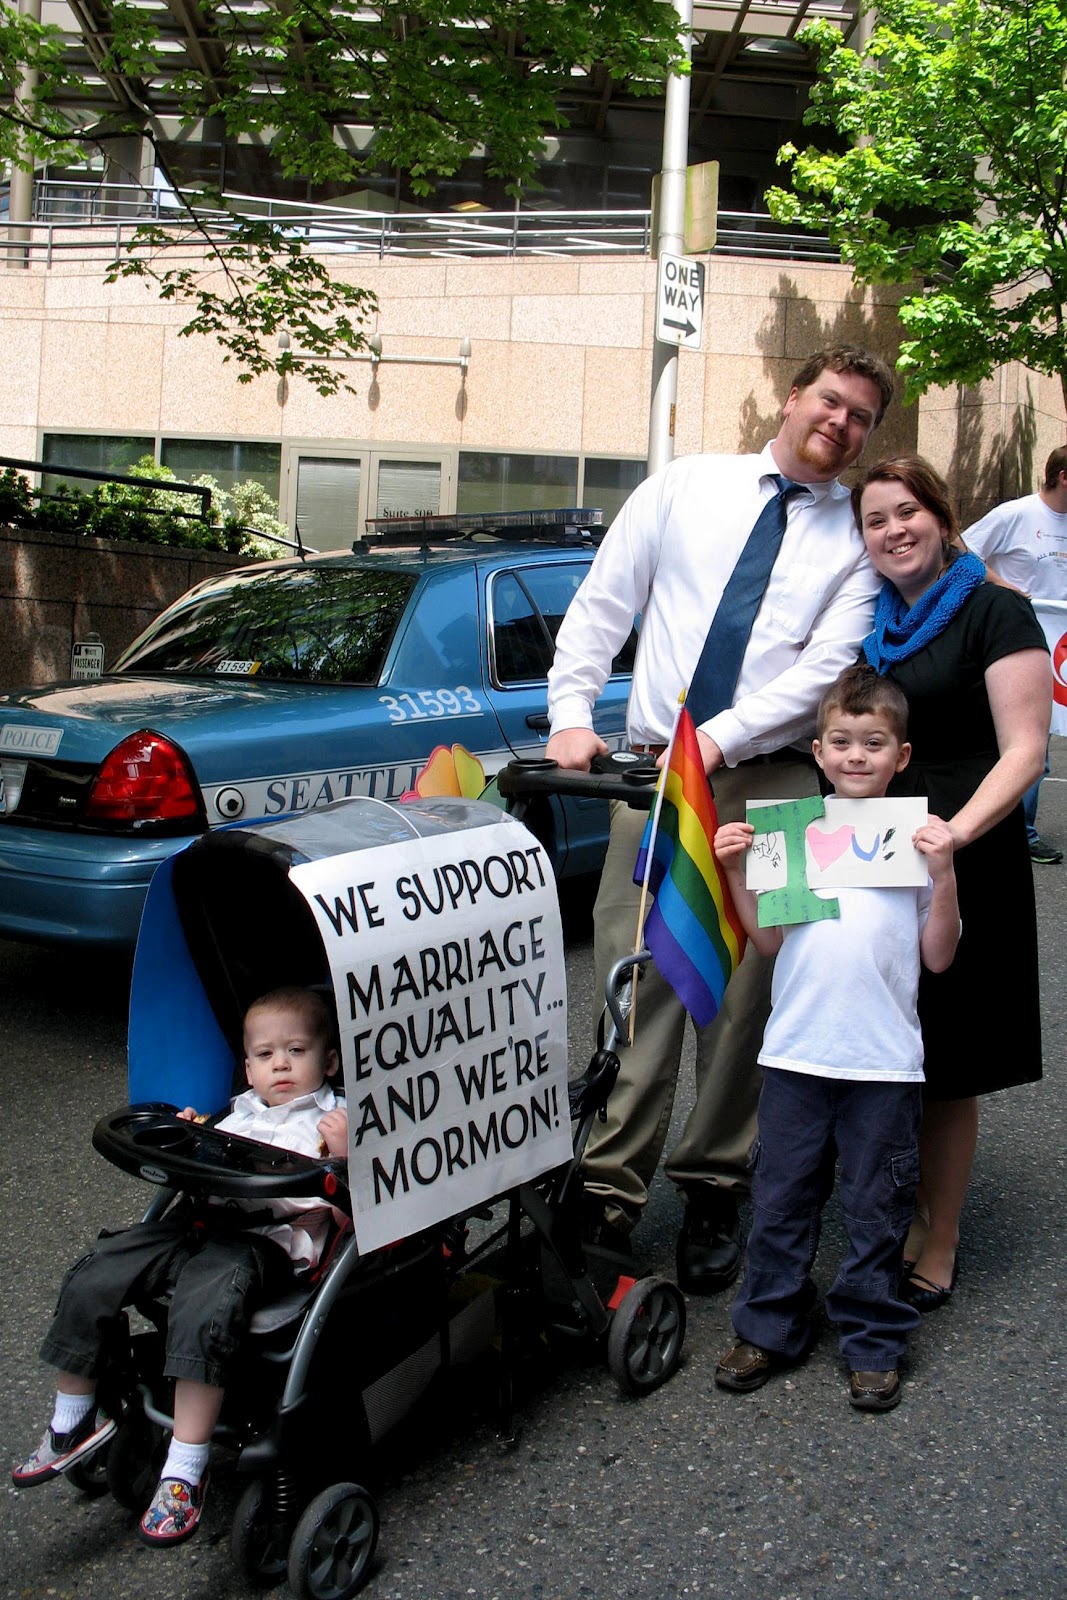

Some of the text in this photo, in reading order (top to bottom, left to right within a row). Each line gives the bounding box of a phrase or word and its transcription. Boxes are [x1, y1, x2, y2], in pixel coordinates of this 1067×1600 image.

[665, 261, 700, 288] ONE
[664, 285, 700, 312] WAY
[383, 506, 409, 518] Suite
[74, 658, 100, 669] PASSENGER
[217, 661, 253, 673] 31593
[378, 685, 482, 722] 31593
[3, 730, 57, 749] POLICE
[314, 846, 547, 937] WE SUPPORT
[345, 915, 546, 1020] MARRIAGE
[353, 971, 564, 1082] EQUALITY...
[354, 1029, 551, 1147] AND WE'RE
[371, 1085, 560, 1204] MORMON!
